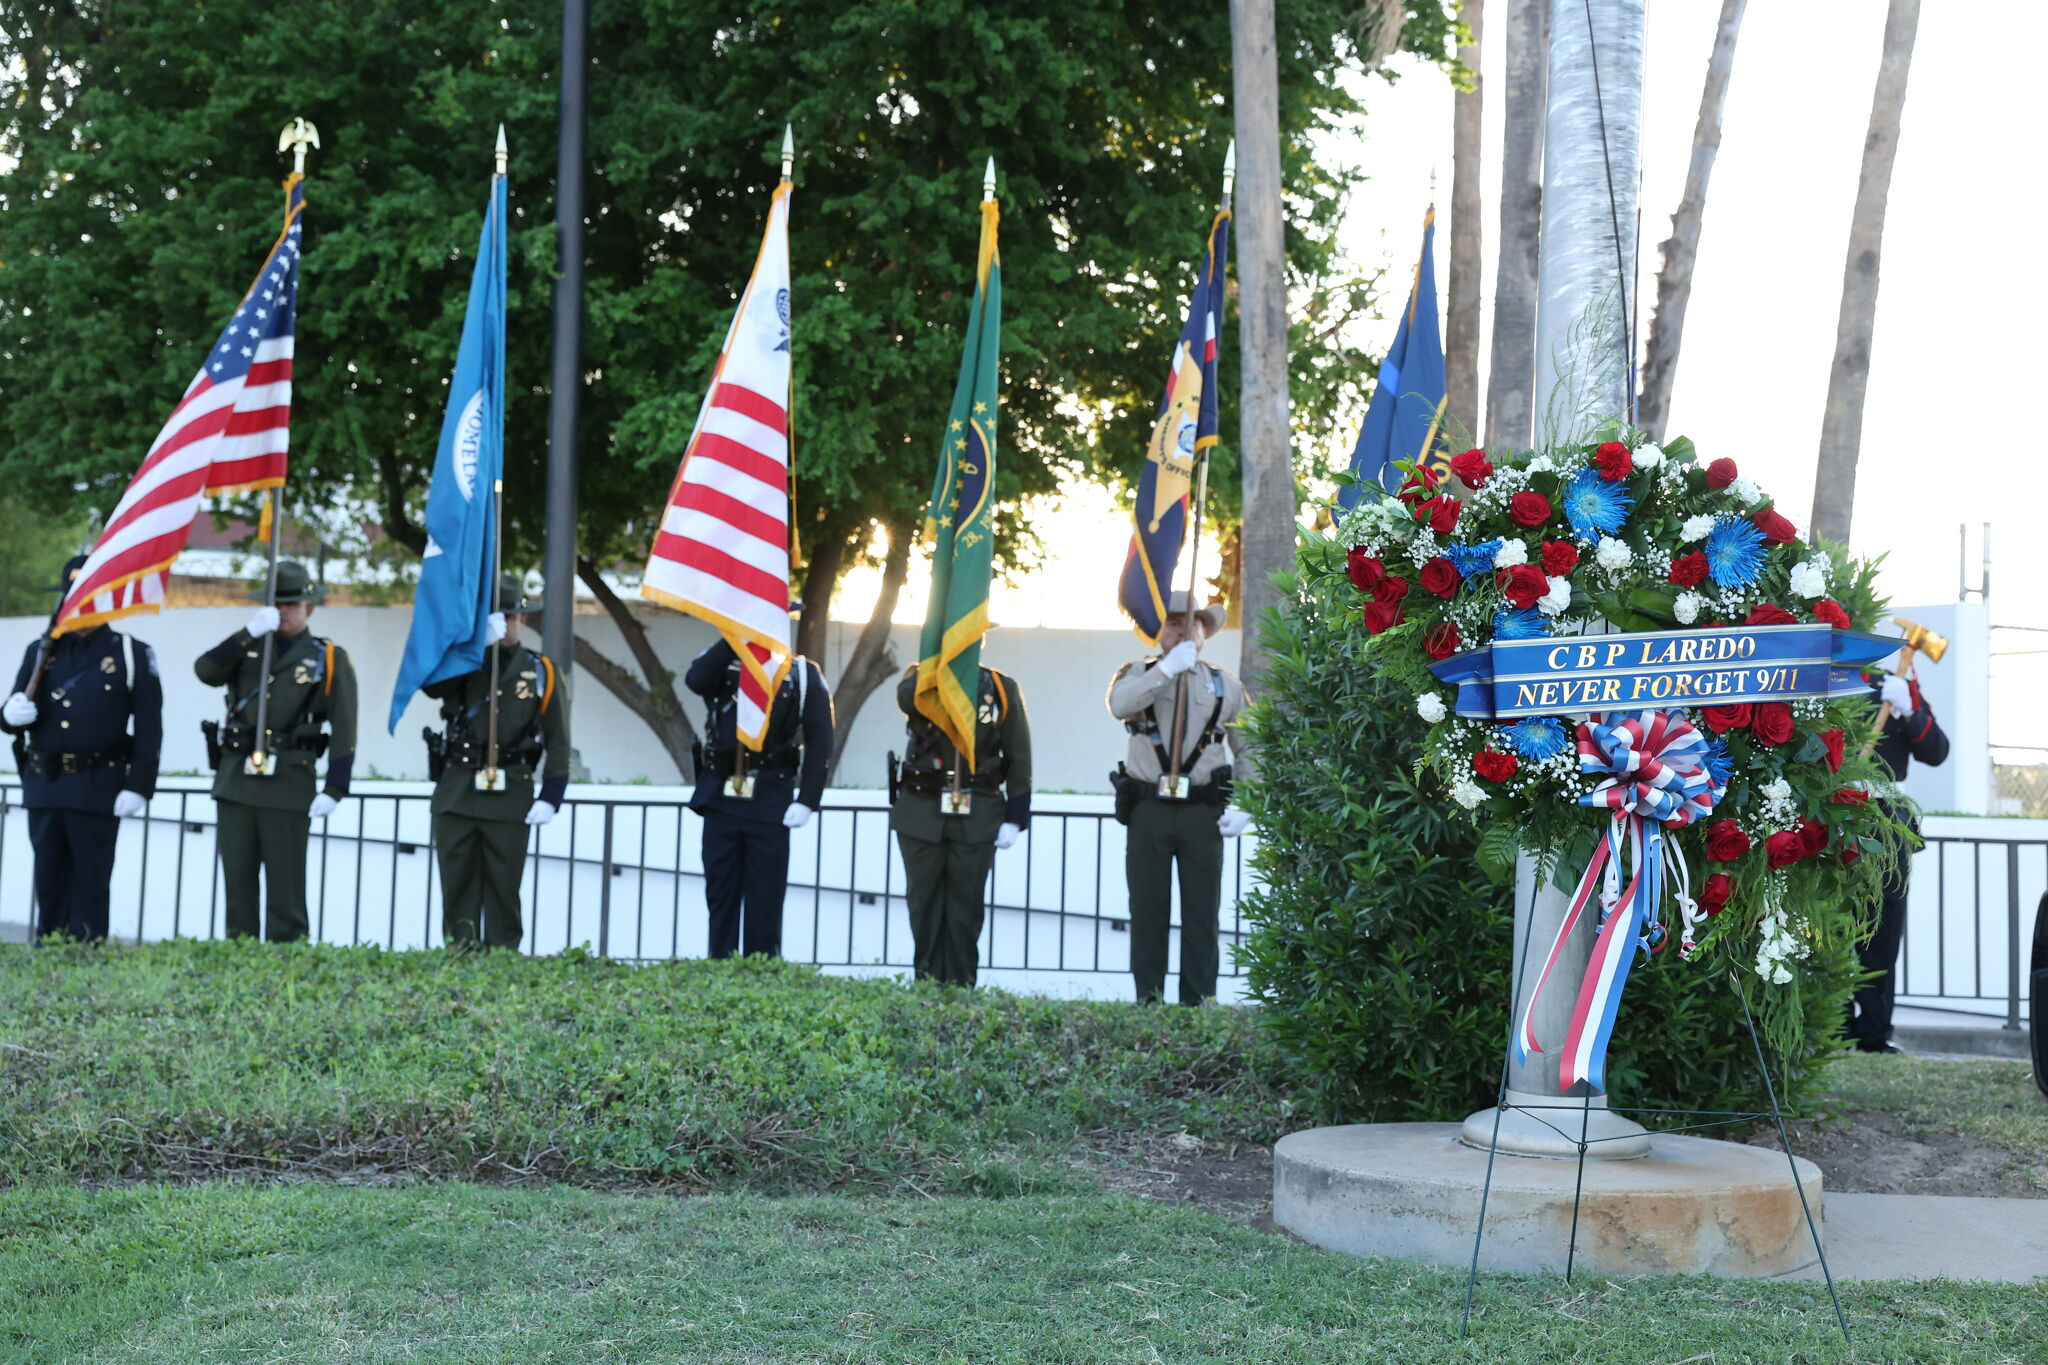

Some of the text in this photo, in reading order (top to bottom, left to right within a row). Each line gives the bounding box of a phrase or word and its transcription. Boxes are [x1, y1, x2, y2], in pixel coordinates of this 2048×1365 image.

[1639, 636, 1756, 665] LAREDO
[1515, 678, 1621, 707] NEVER
[1630, 670, 1750, 699] FORGET
[1756, 668, 1799, 692] 9/11
